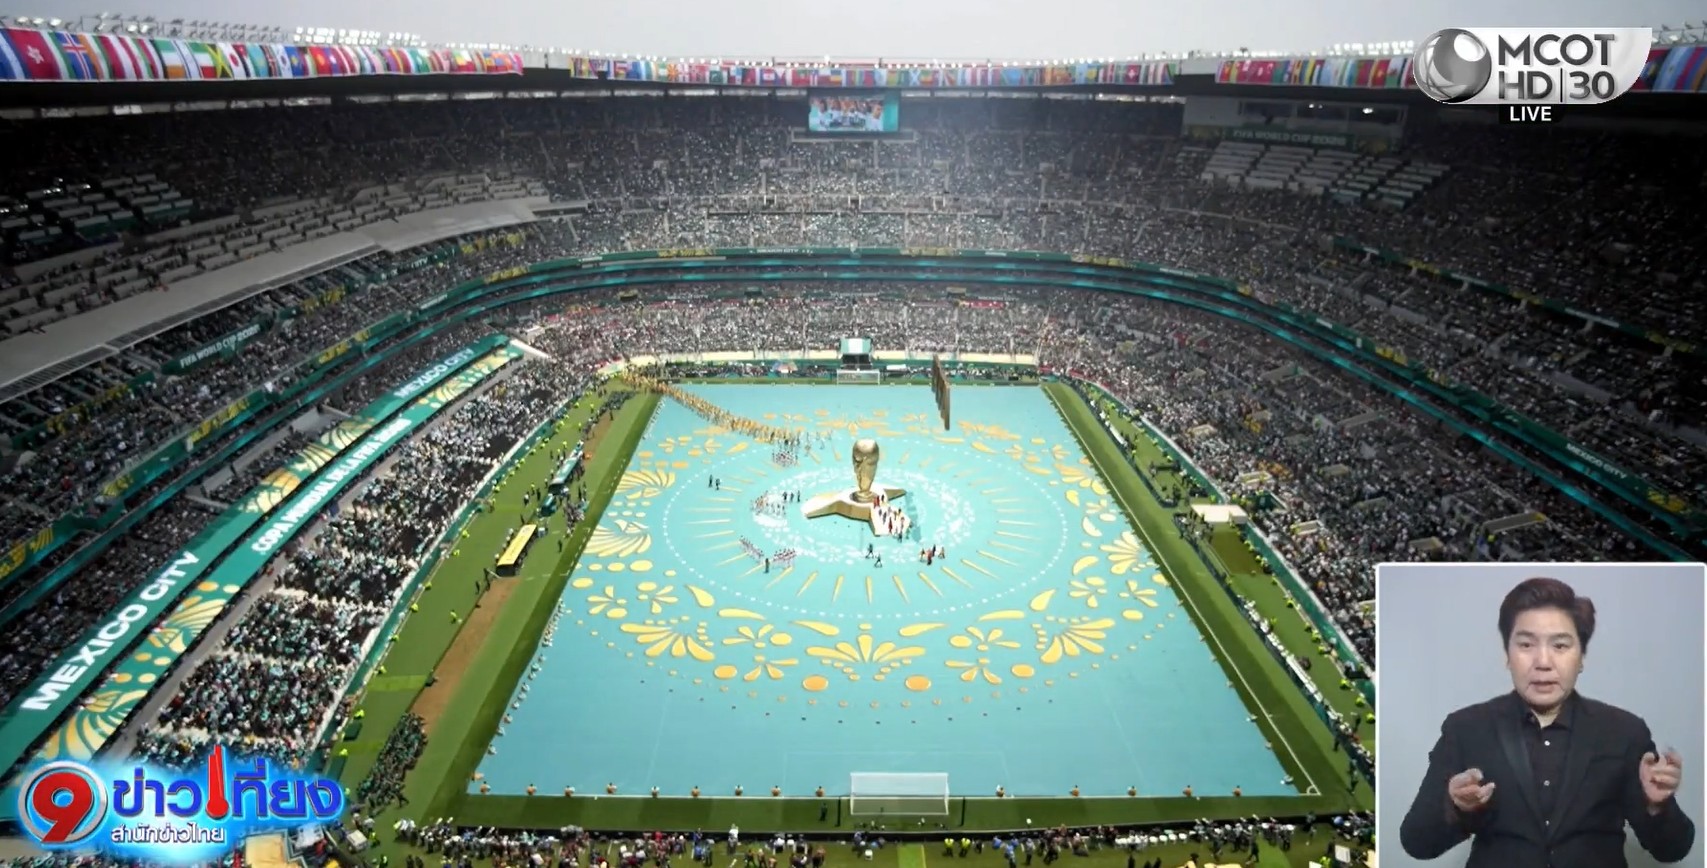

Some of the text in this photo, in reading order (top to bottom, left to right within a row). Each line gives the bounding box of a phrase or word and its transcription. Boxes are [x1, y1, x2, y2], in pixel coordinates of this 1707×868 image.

[393, 364, 448, 399] MEXICO
[251, 522, 294, 551] COPA
[280, 481, 338, 524] MUNDIAL
[20, 551, 200, 710] MEXICO CITY
